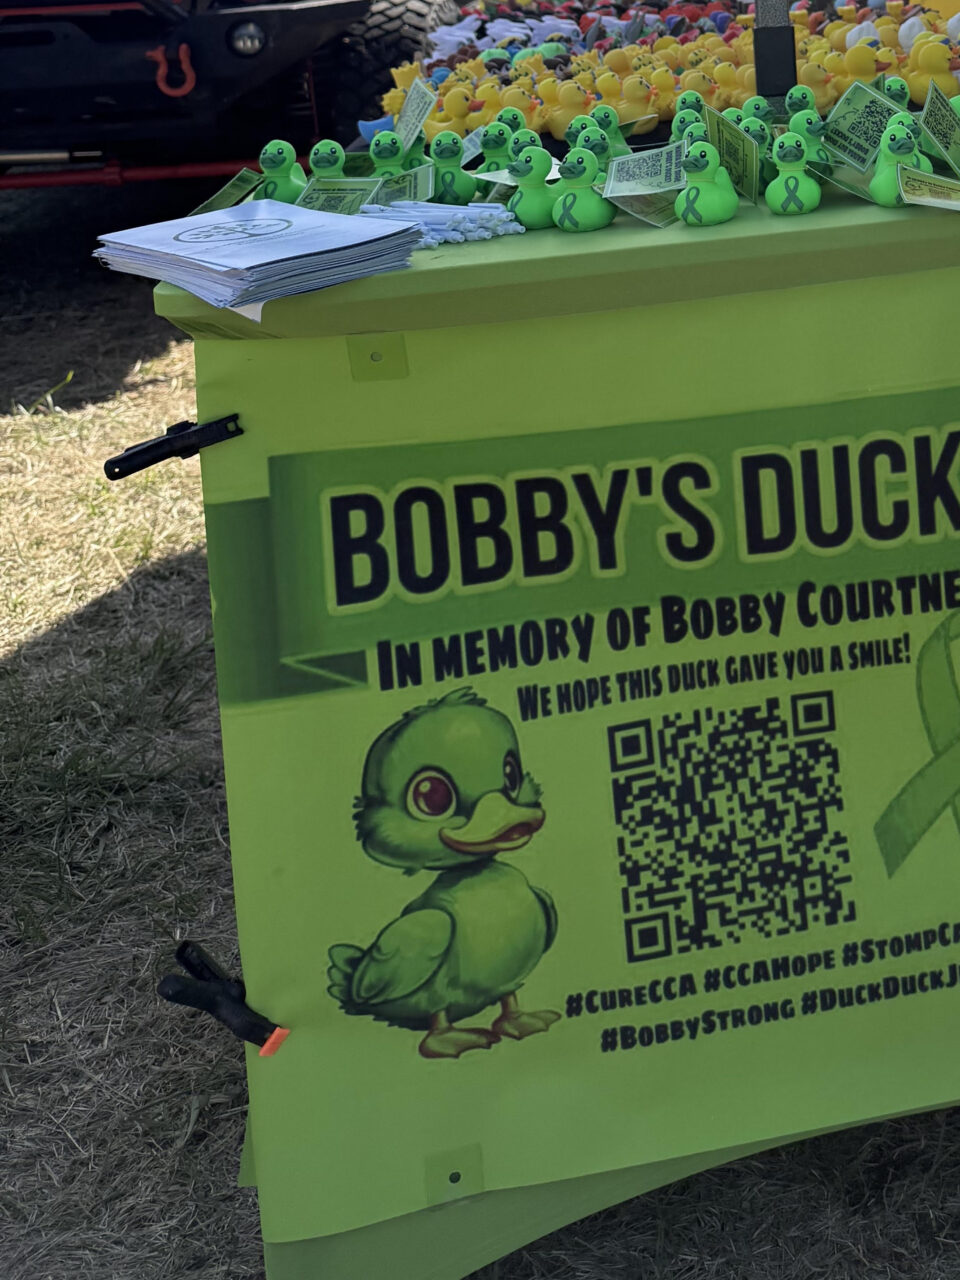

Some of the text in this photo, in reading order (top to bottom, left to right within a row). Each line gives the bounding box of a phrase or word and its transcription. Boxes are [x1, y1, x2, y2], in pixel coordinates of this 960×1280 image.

[330, 461, 715, 607] BOBBY'S
[660, 591, 786, 643] BOBBY
[616, 665, 663, 702] THIS
[667, 658, 720, 694] DUCK
[725, 651, 778, 685] GAVE
[829, 644, 844, 671] A
